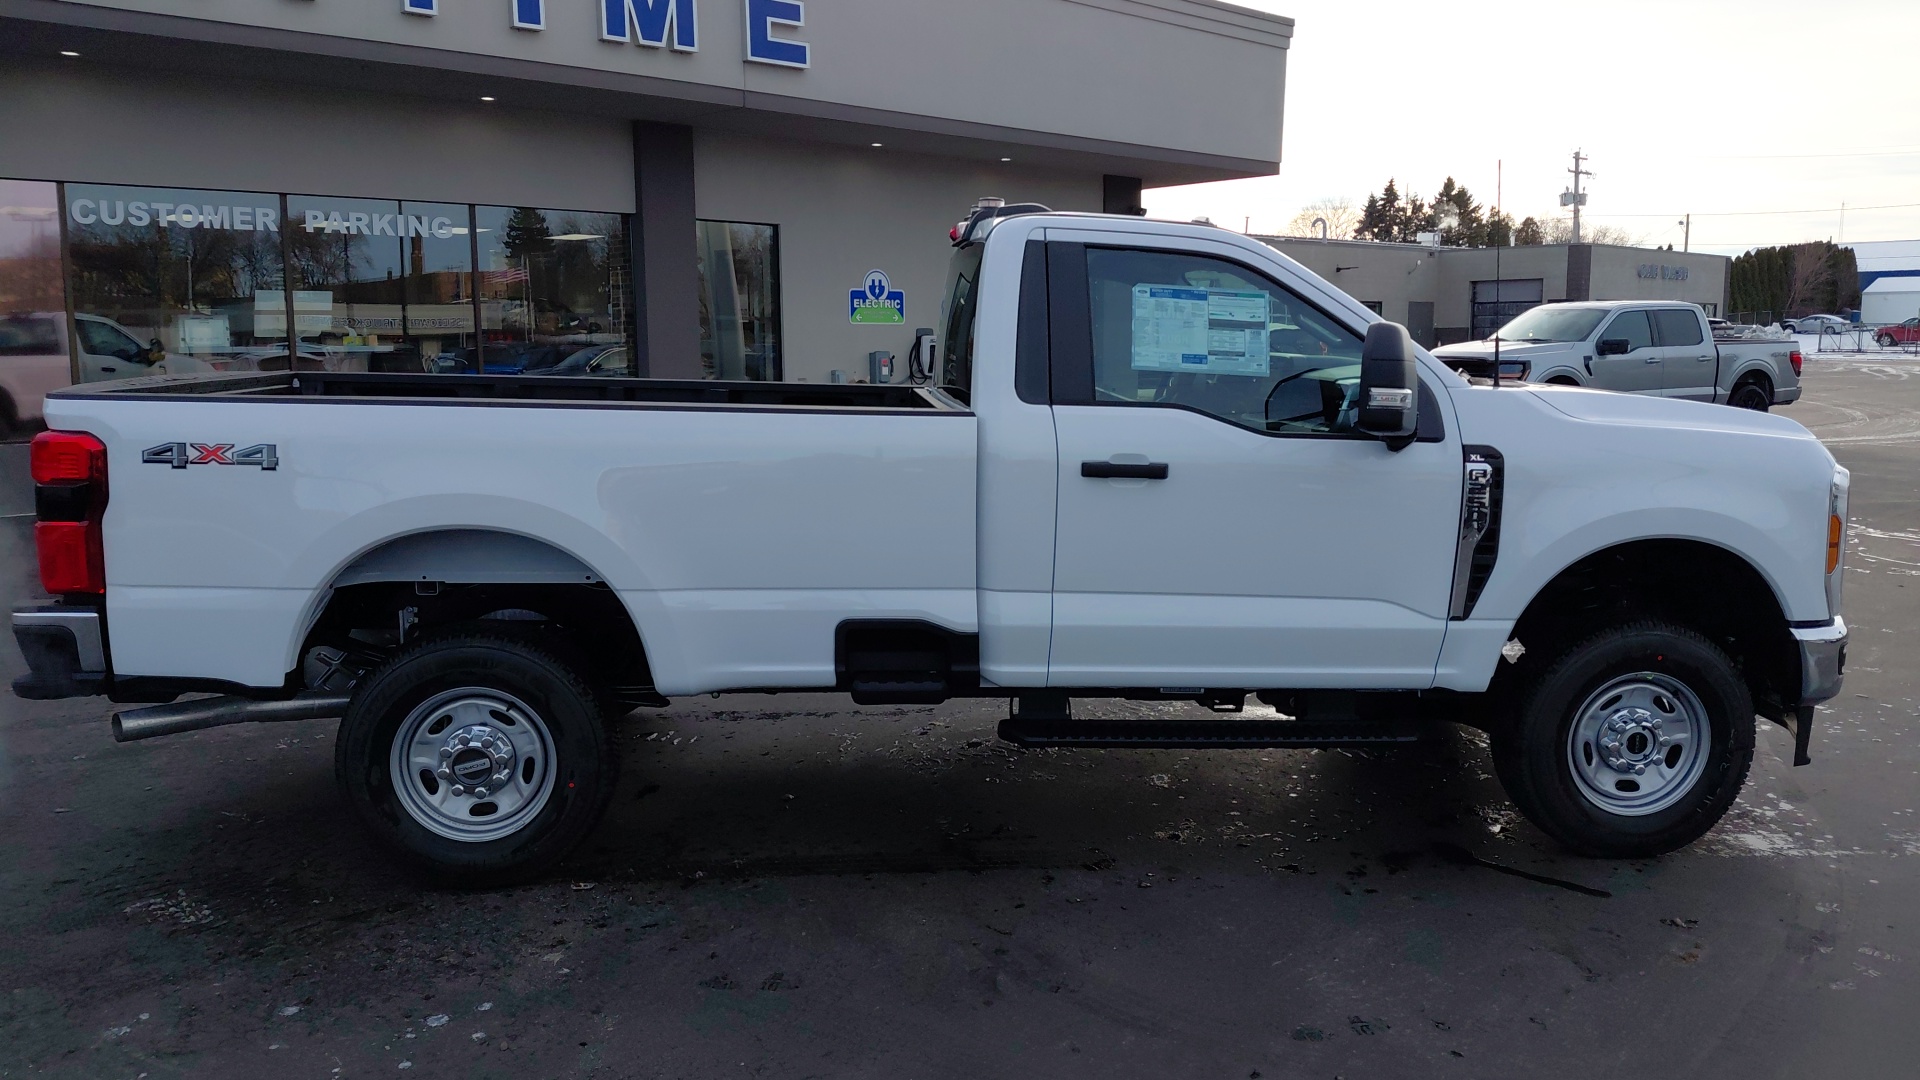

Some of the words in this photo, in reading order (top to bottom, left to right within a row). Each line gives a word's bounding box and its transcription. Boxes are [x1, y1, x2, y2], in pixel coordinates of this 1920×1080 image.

[71, 198, 279, 232] CUSTOMER
[304, 209, 453, 239] PARKING
[853, 298, 901, 309] ELECTRIC
[1469, 453, 1485, 461] XL
